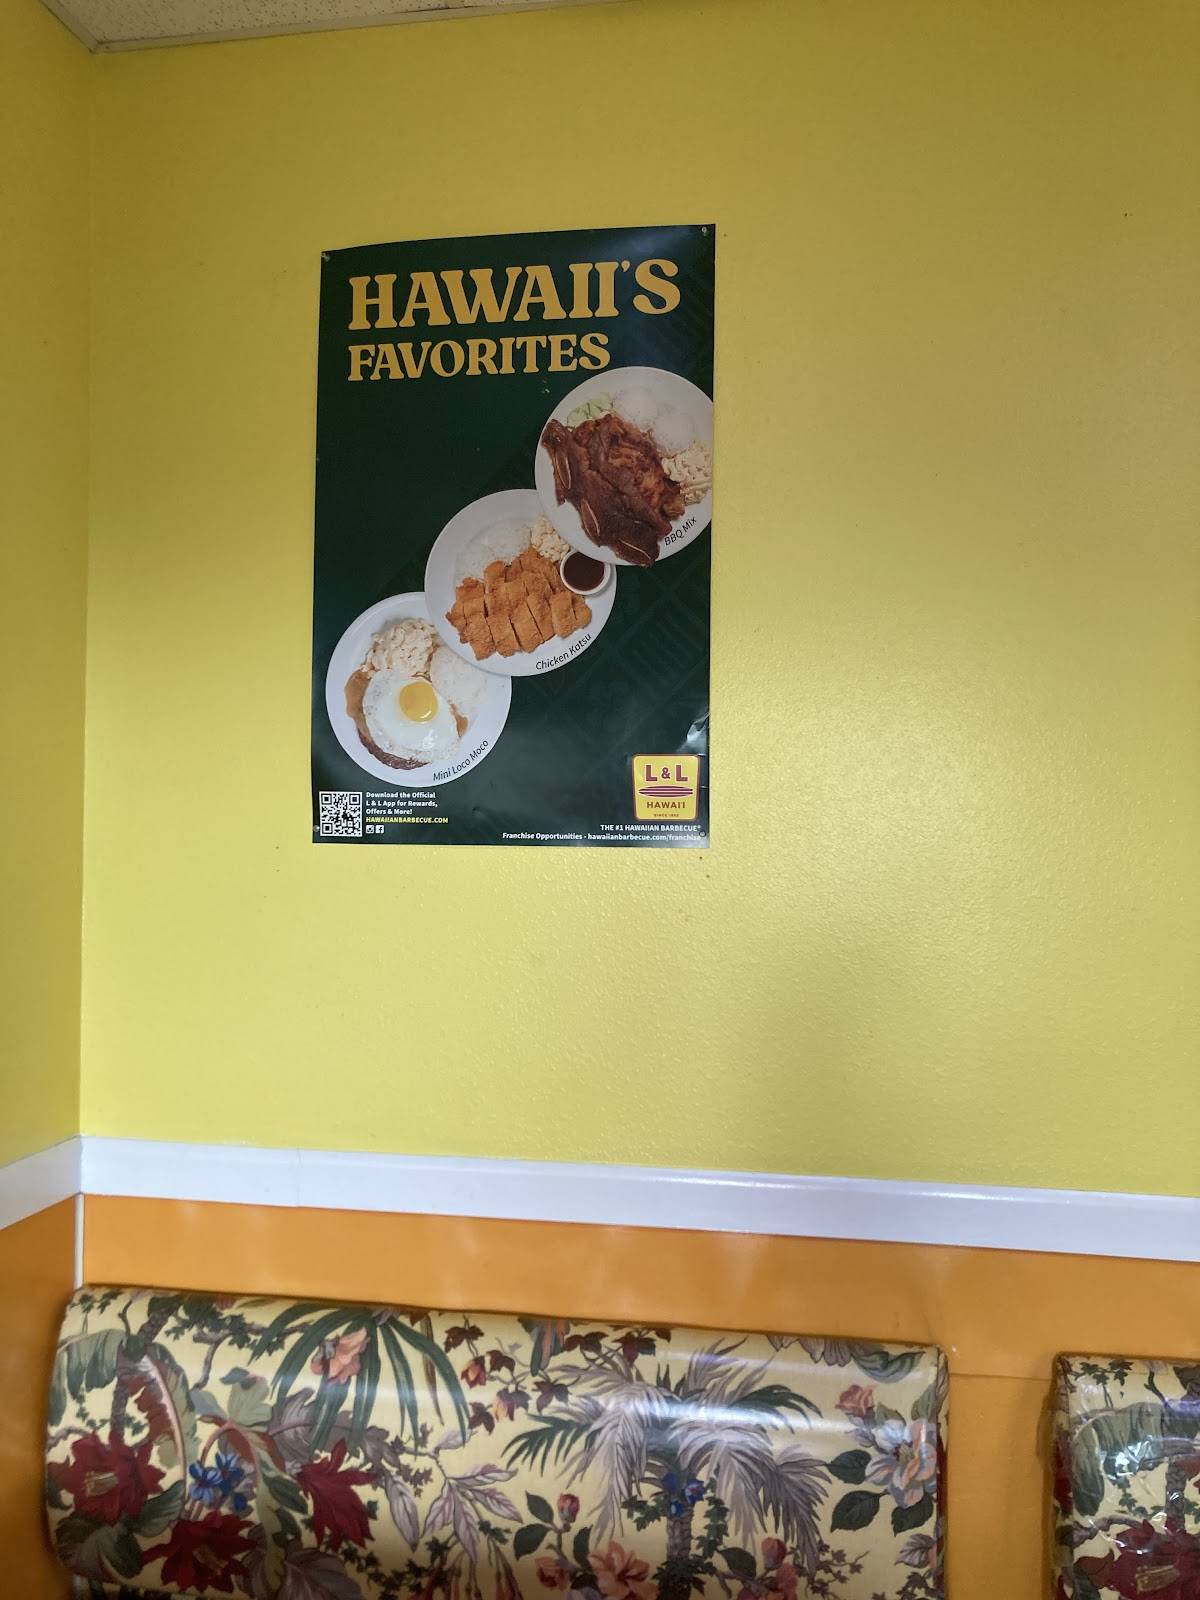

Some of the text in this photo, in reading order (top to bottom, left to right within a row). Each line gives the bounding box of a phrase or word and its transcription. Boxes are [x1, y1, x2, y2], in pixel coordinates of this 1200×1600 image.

[348, 258, 681, 330] HAWAII'S
[348, 333, 611, 381] FAVORITES
[664, 516, 697, 546] BBQ Mix
[535, 634, 592, 670] Chicken Katsu
[433, 740, 489, 781] Mini Loco Moco
[645, 764, 689, 782] L & L
[408, 800, 438, 808] Rewards,
[535, 832, 583, 841] Opportunities
